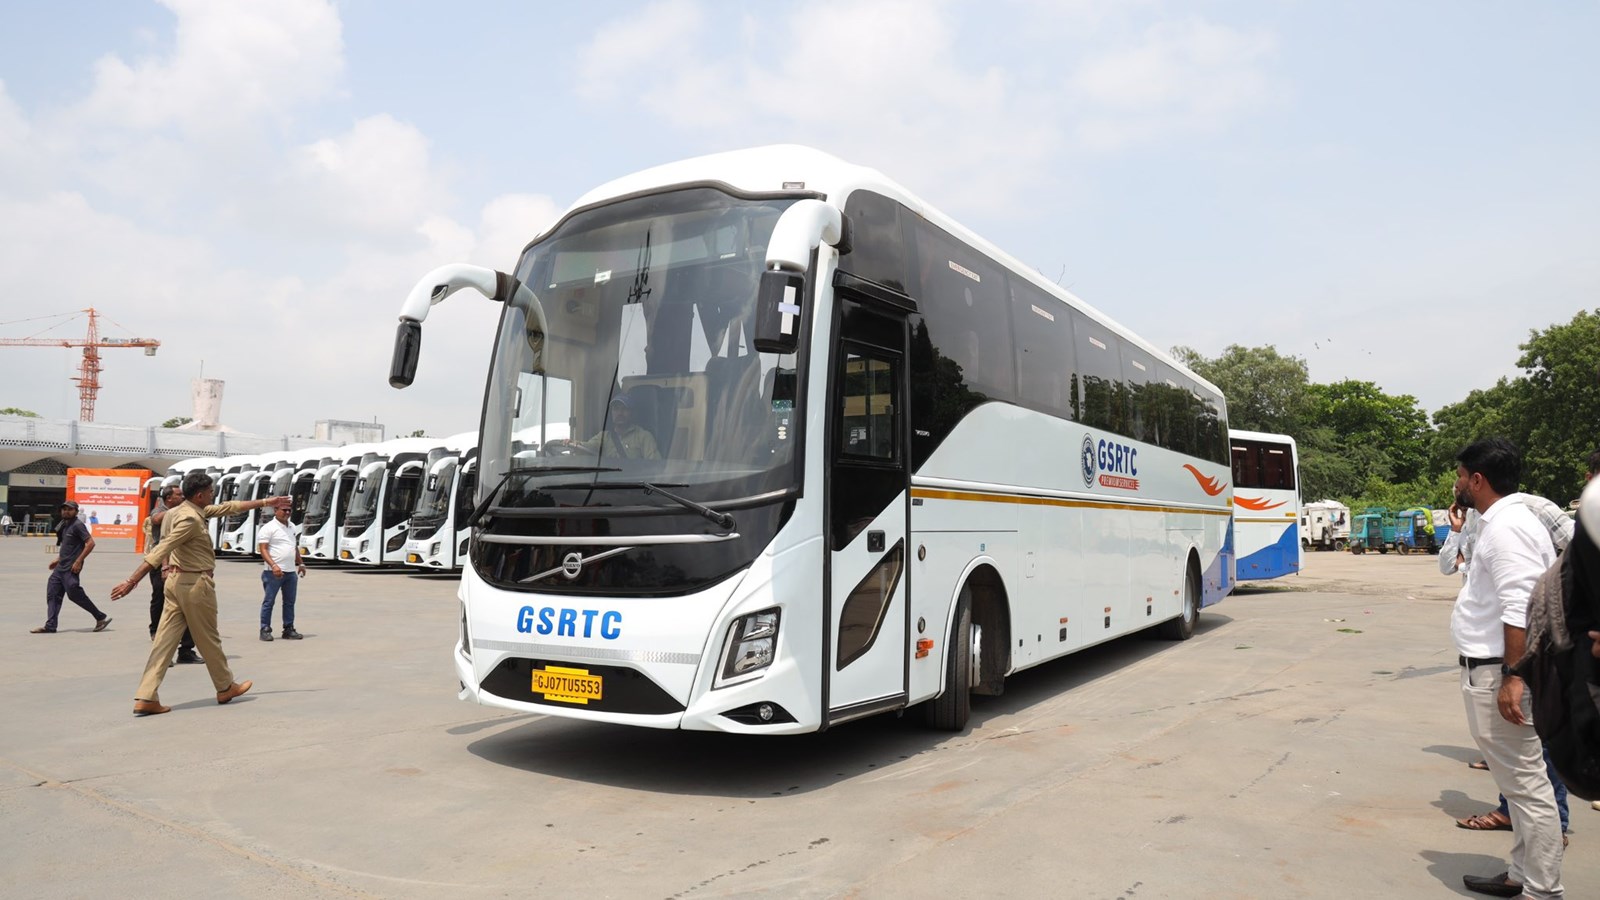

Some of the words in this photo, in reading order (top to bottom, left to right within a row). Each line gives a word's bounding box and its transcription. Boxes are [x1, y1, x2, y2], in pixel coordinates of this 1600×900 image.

[1098, 438, 1137, 476] GSRTC
[517, 605, 622, 640] GSRTC
[538, 675, 600, 695] GJ07TU5553
